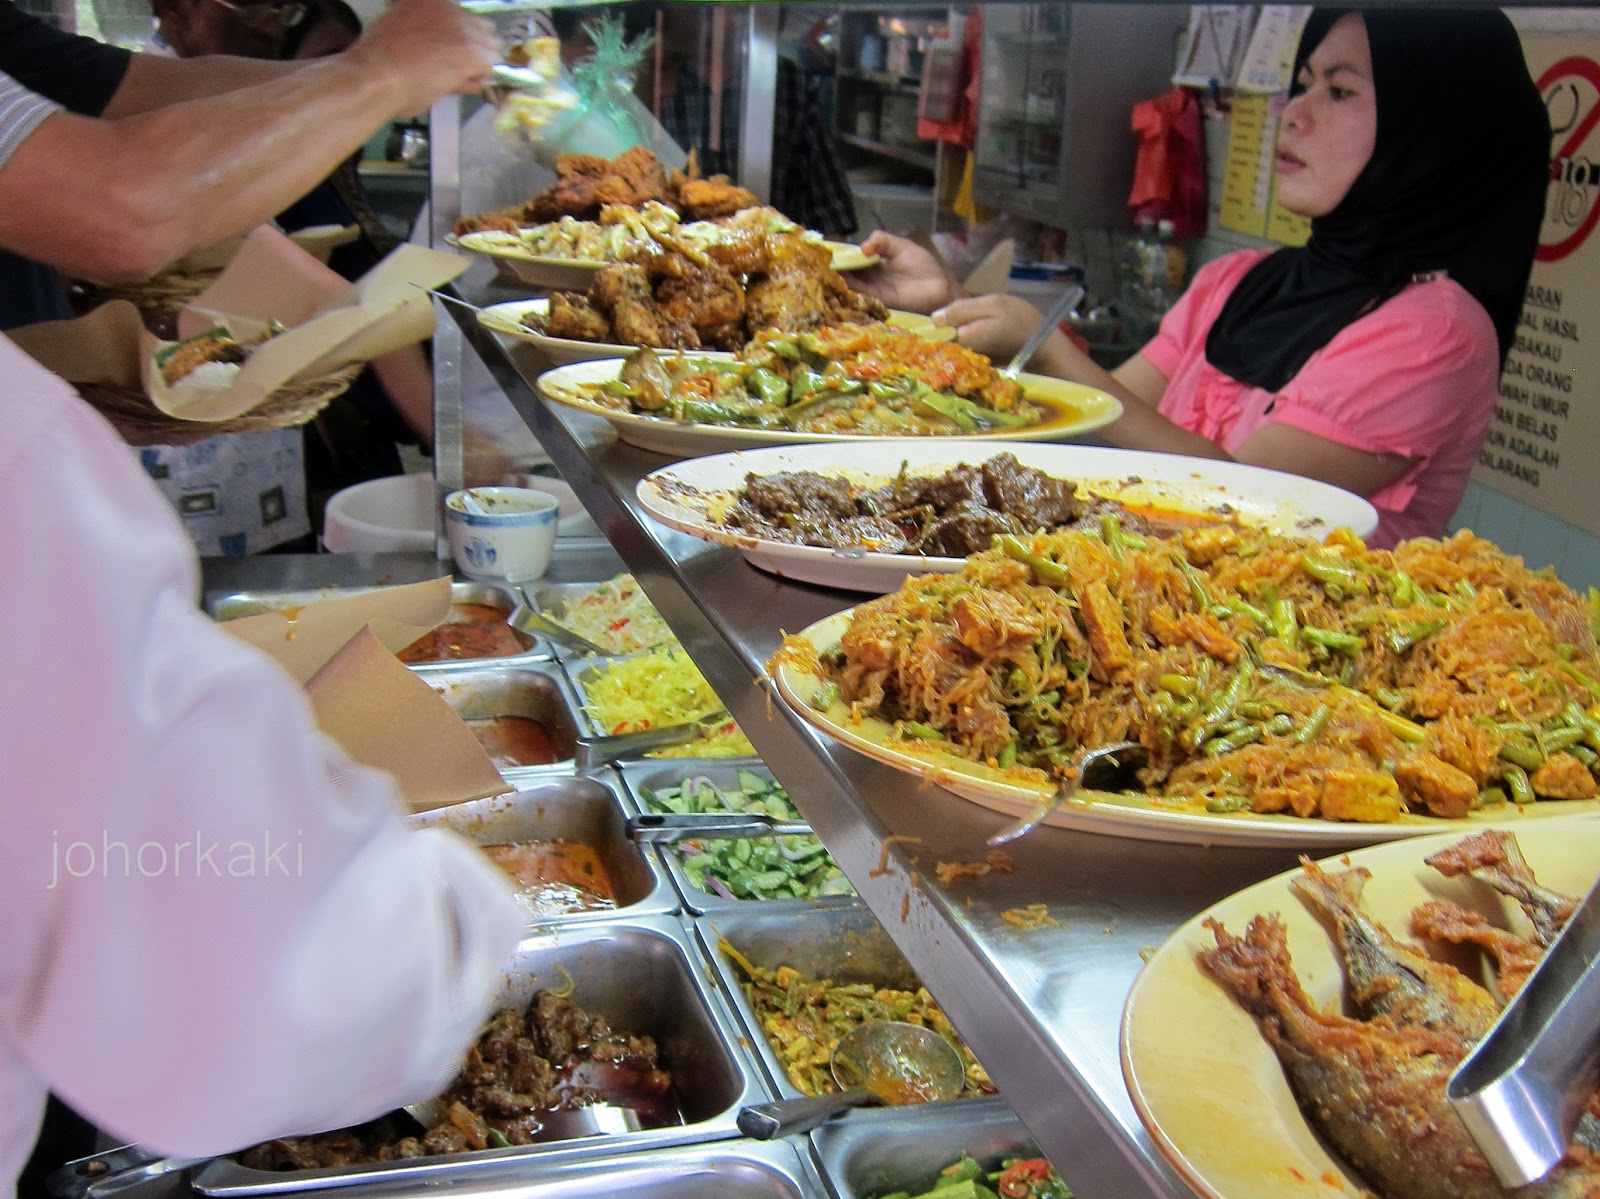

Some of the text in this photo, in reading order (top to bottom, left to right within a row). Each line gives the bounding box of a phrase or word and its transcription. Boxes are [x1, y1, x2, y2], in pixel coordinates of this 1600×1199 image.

[1542, 316, 1579, 342] HASIL
[1514, 335, 1562, 363] BAKAU
[1526, 364, 1572, 391] ORANG
[1532, 392, 1569, 419] UMUR
[1517, 412, 1558, 442] BELAS
[1508, 436, 1559, 469] ADALAH
